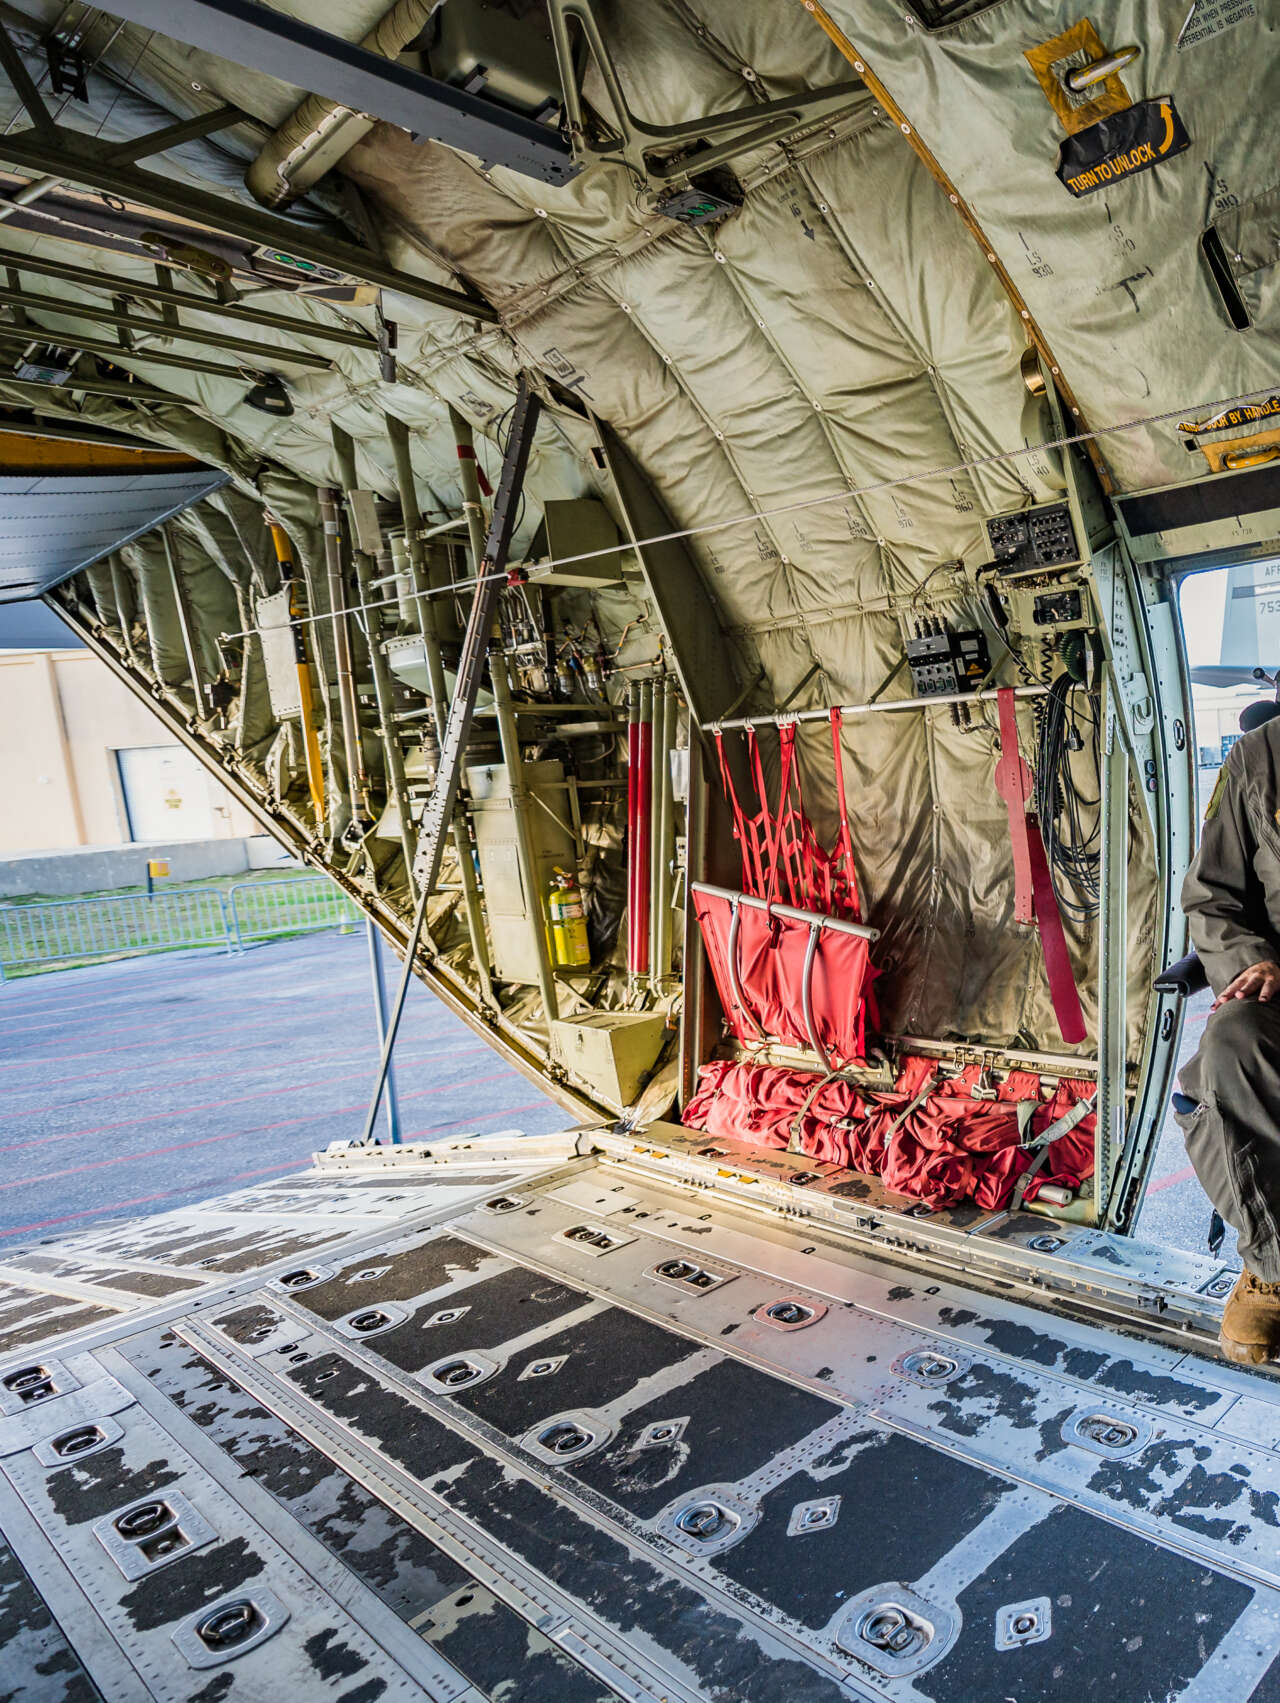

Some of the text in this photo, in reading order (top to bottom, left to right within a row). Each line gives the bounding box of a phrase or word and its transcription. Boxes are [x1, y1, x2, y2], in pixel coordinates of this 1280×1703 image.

[1225, 4, 1256, 25] NEGATIVE
[1067, 141, 1157, 193] TURN TO UNLOCK
[1229, 408, 1243, 425] BY
